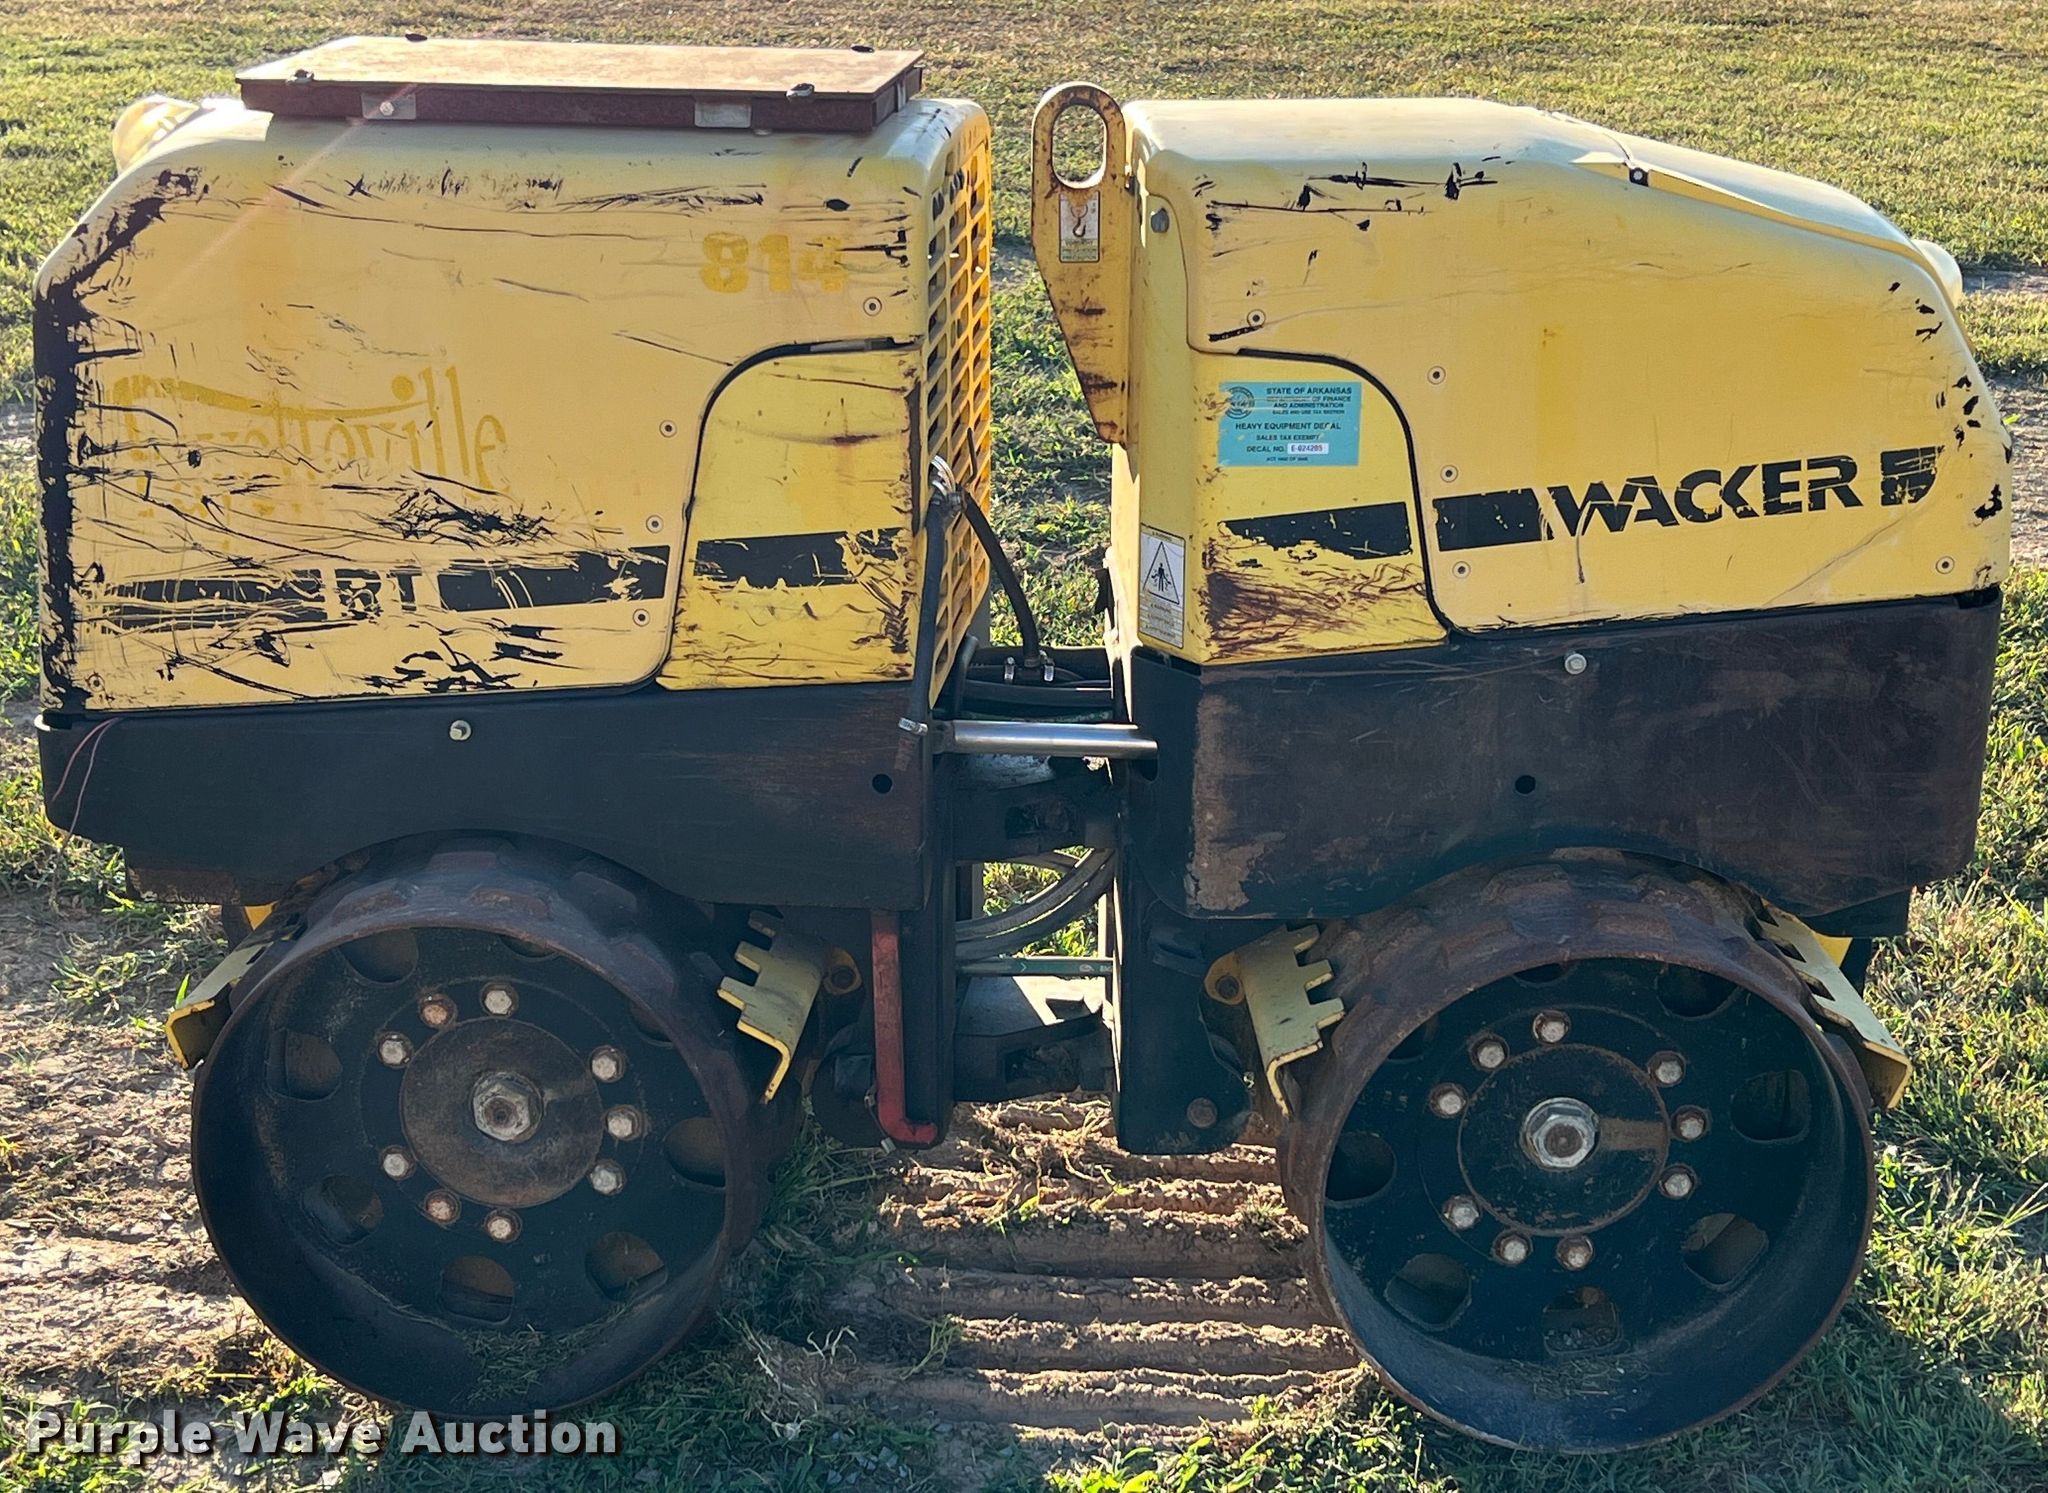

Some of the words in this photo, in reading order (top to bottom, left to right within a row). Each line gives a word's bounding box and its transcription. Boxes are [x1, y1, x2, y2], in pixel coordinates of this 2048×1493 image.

[1266, 387, 1291, 395] STATE
[1293, 387, 1305, 395] OF
[1307, 386, 1352, 395] ARKANSAS
[1235, 422, 1262, 430] HEAVY
[1264, 422, 1311, 430] EQUIPMENT
[1246, 445, 1271, 453] DECAL
[1547, 455, 1858, 539] WACKER
